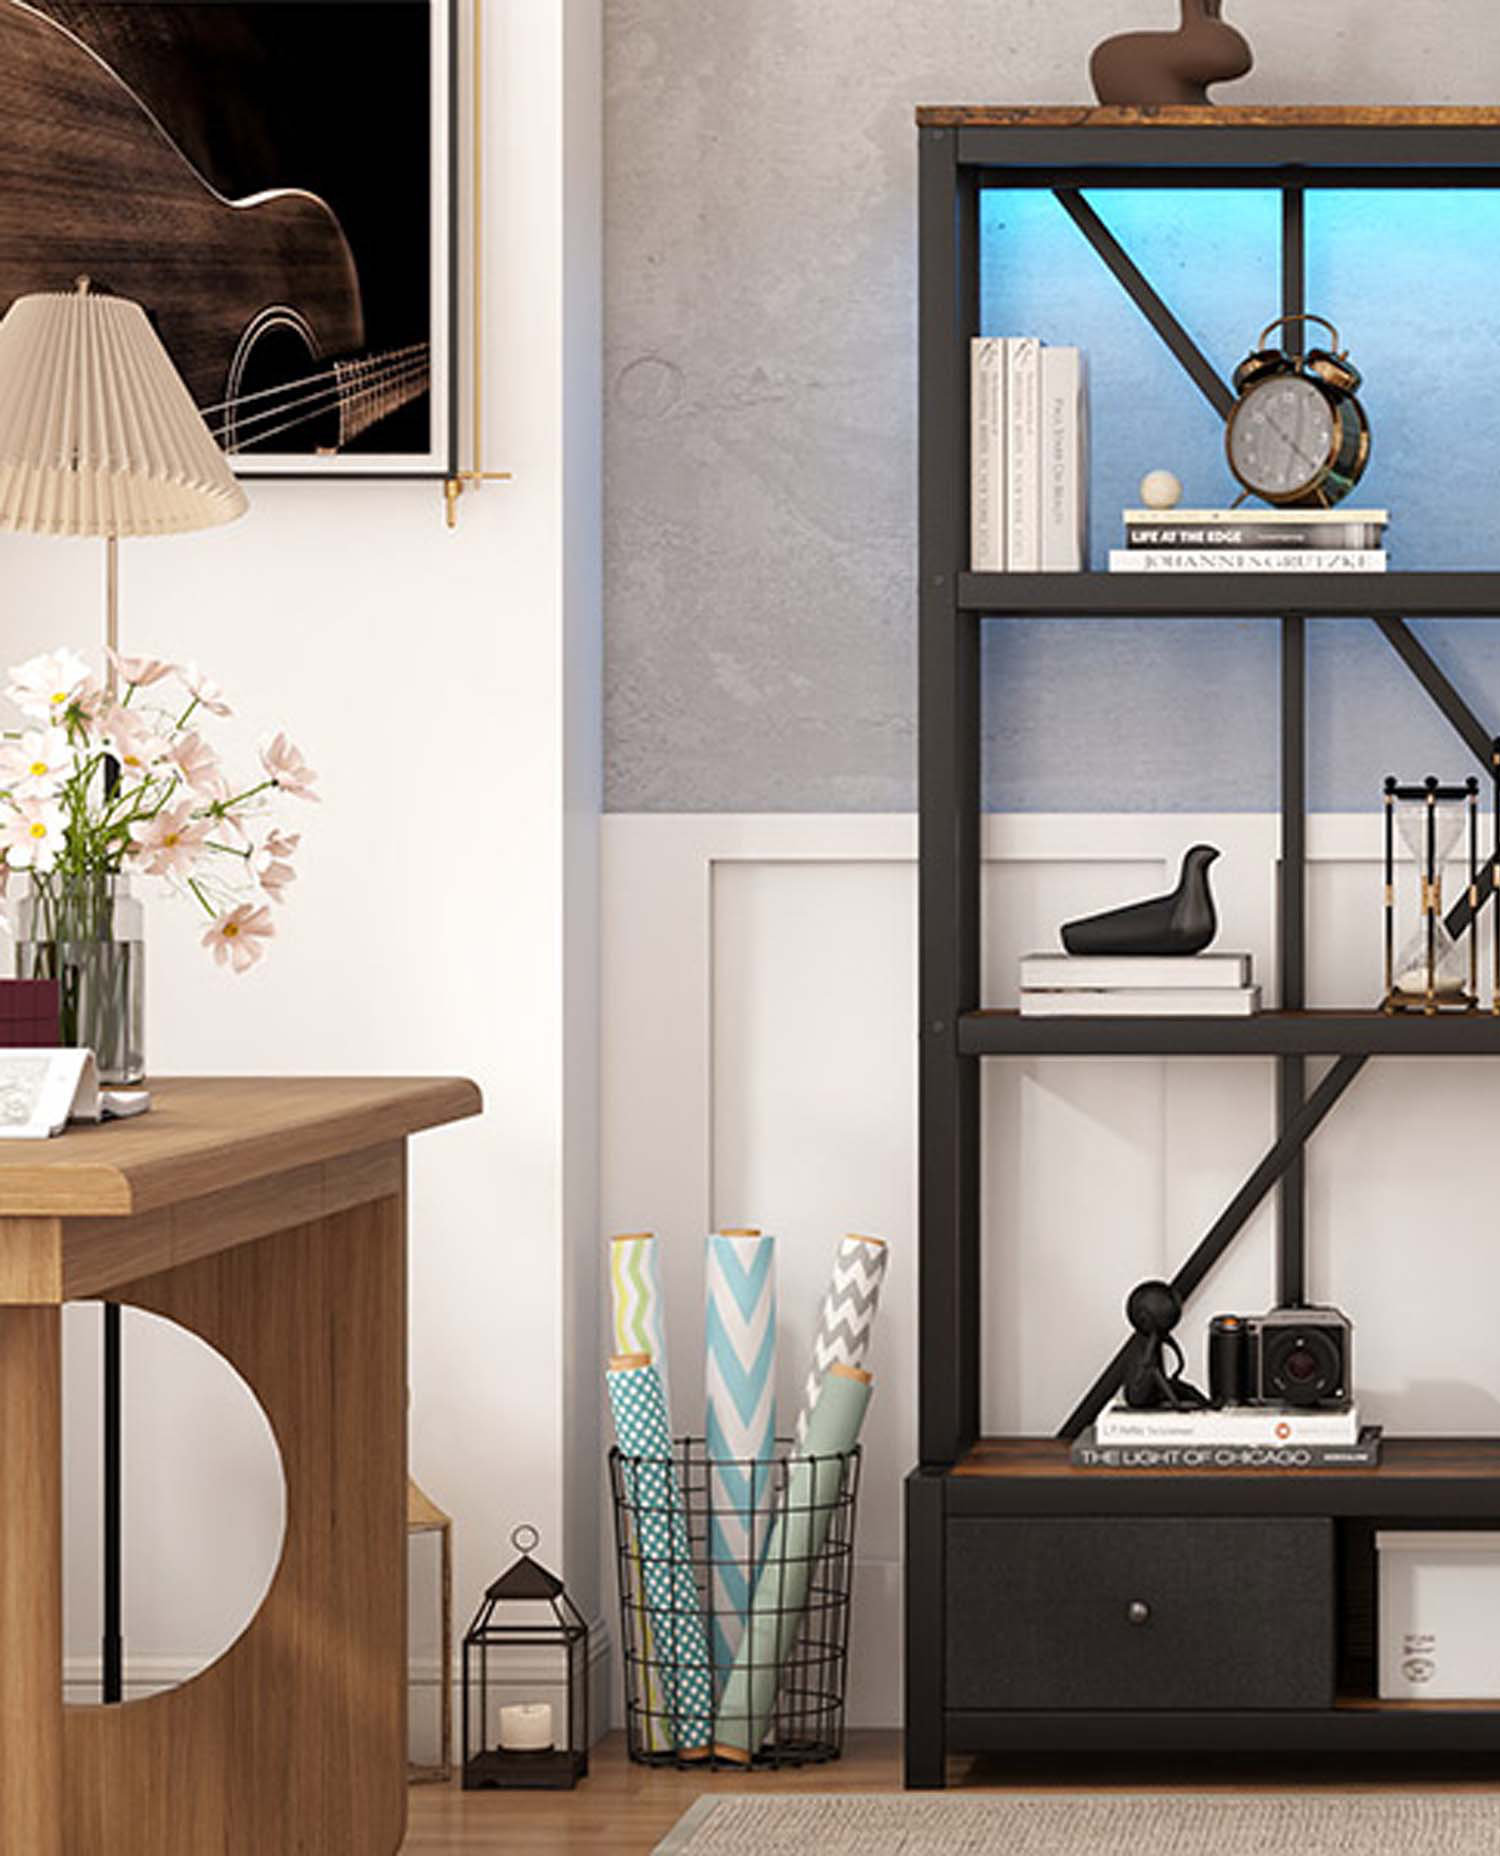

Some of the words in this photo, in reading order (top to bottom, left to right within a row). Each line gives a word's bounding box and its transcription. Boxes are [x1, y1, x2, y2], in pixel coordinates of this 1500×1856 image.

[1131, 530, 1158, 544] LIFE
[1160, 530, 1177, 544] AT
[1179, 530, 1205, 544] THE
[1207, 530, 1243, 544] EDGE
[1081, 1450, 1120, 1465] THE
[1123, 1450, 1178, 1466] LIGHT
[1183, 1450, 1212, 1466] OF
[1215, 1449, 1311, 1466] CHICAGO
